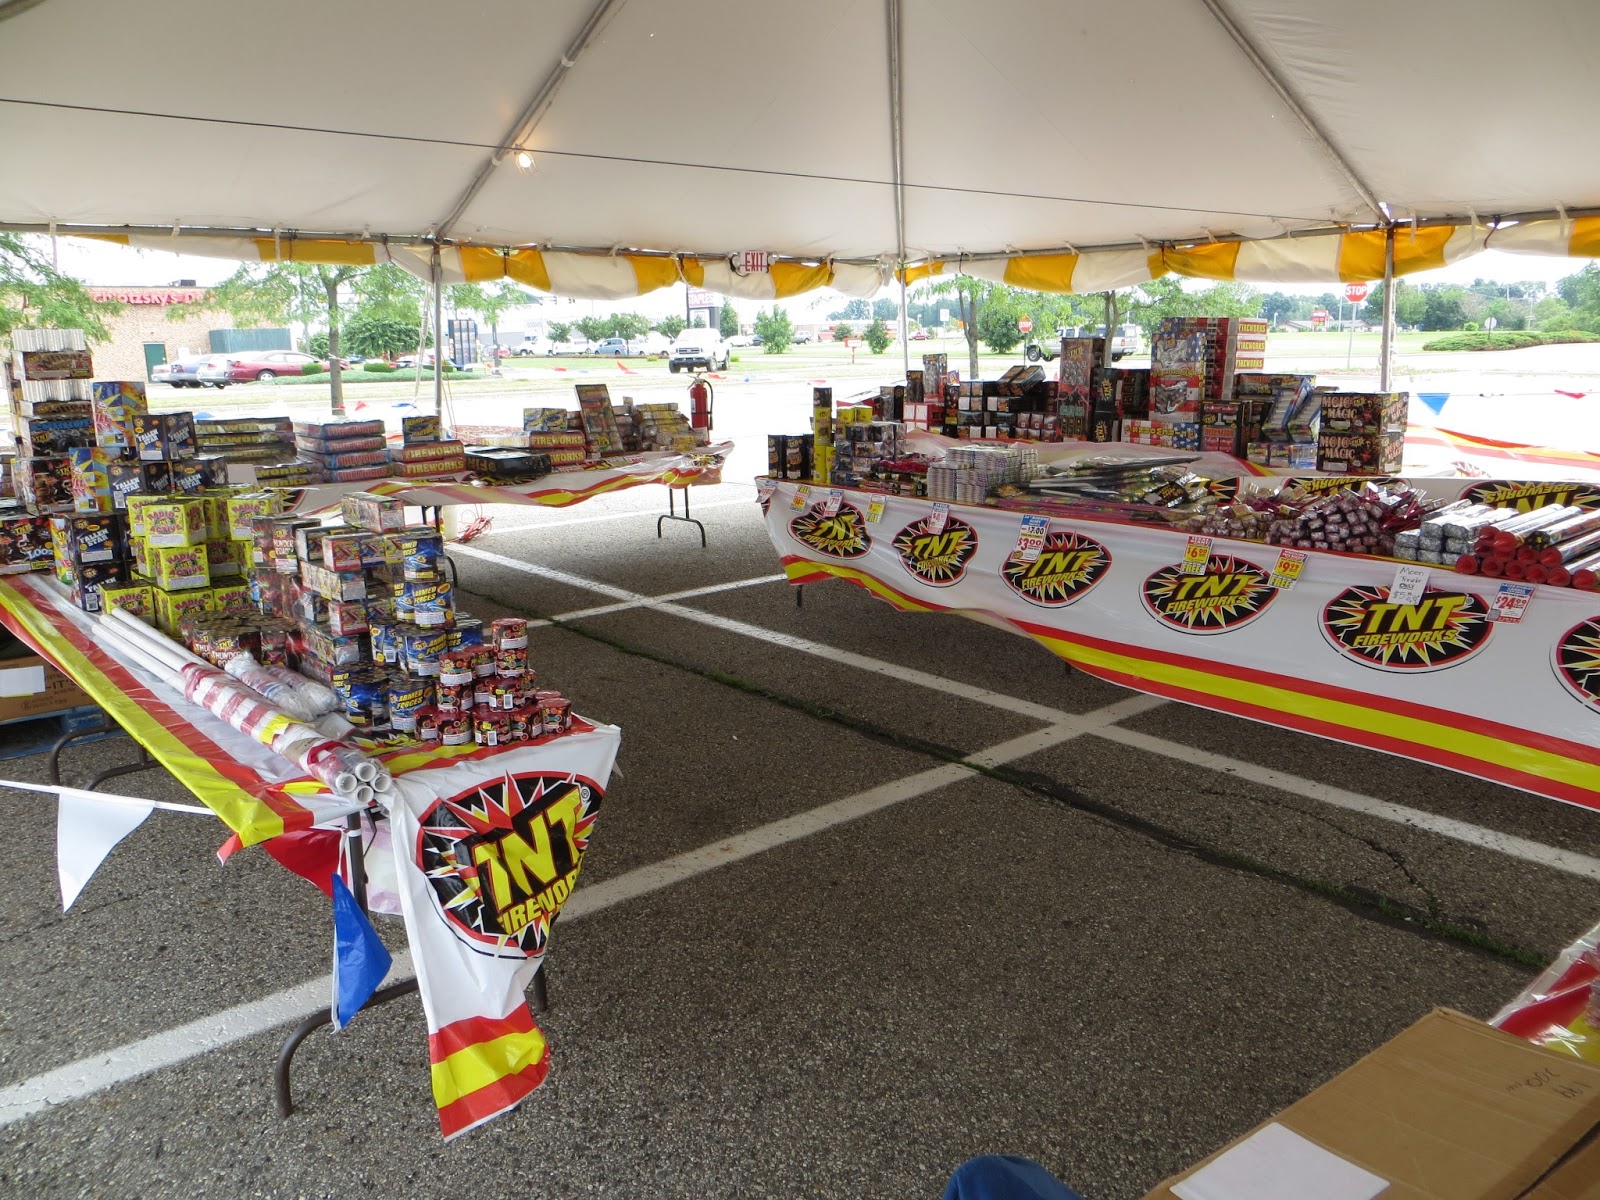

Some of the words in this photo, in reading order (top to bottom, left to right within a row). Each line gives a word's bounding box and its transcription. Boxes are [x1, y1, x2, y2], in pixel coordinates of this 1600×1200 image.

[745, 252, 764, 272] EXIT
[1345, 285, 1368, 296] STOP
[1239, 323, 1266, 333] FIREWORKS
[1238, 341, 1266, 351] FIREWORKS
[1236, 358, 1263, 368] FIREWORKS
[1322, 396, 1351, 408] MOJO
[1328, 408, 1357, 419] MAGIC
[136, 428, 159, 443] FALLEN
[328, 424, 379, 436] FIREWORKS
[329, 438, 381, 450] FIREWORKS
[531, 434, 583, 446] FIREWORKS
[1320, 436, 1350, 448] MOJO
[405, 444, 463, 460] FIREWORKS
[1325, 448, 1355, 460] MAGIC
[336, 452, 387, 465] FIREWORKS
[406, 458, 465, 474] FIREWORKS
[175, 473, 202, 487] FALLEN
[337, 468, 389, 480] FIREWORKS
[113, 477, 140, 491] FALLEN
[122, 484, 140, 494] STAR
[183, 480, 202, 490] STAR
[15, 524, 30, 534] TNT
[814, 514, 856, 540] TNT
[77, 528, 109, 544] FALLEN
[87, 535, 108, 547] STAR
[802, 533, 862, 548] FIREWORKS
[914, 529, 970, 560] TNT
[916, 554, 957, 571] FIREWORKS
[1029, 549, 1102, 580] TNT
[1183, 564, 1201, 573] FREE
[170, 566, 205, 577] ACTIVE
[1021, 570, 1087, 590] FIREWORKS
[1270, 576, 1291, 588] FREE
[415, 585, 437, 597] ARMED
[1175, 573, 1260, 600] TNT
[414, 593, 436, 604] FORCES
[1166, 594, 1250, 614] FIREWORKS
[1364, 594, 1468, 634] TNT
[1353, 628, 1459, 647] FIREWORKS
[219, 640, 232, 648] TNT
[399, 690, 423, 702] ARMED
[397, 697, 423, 710] FORCES
[473, 787, 584, 912] TNT
